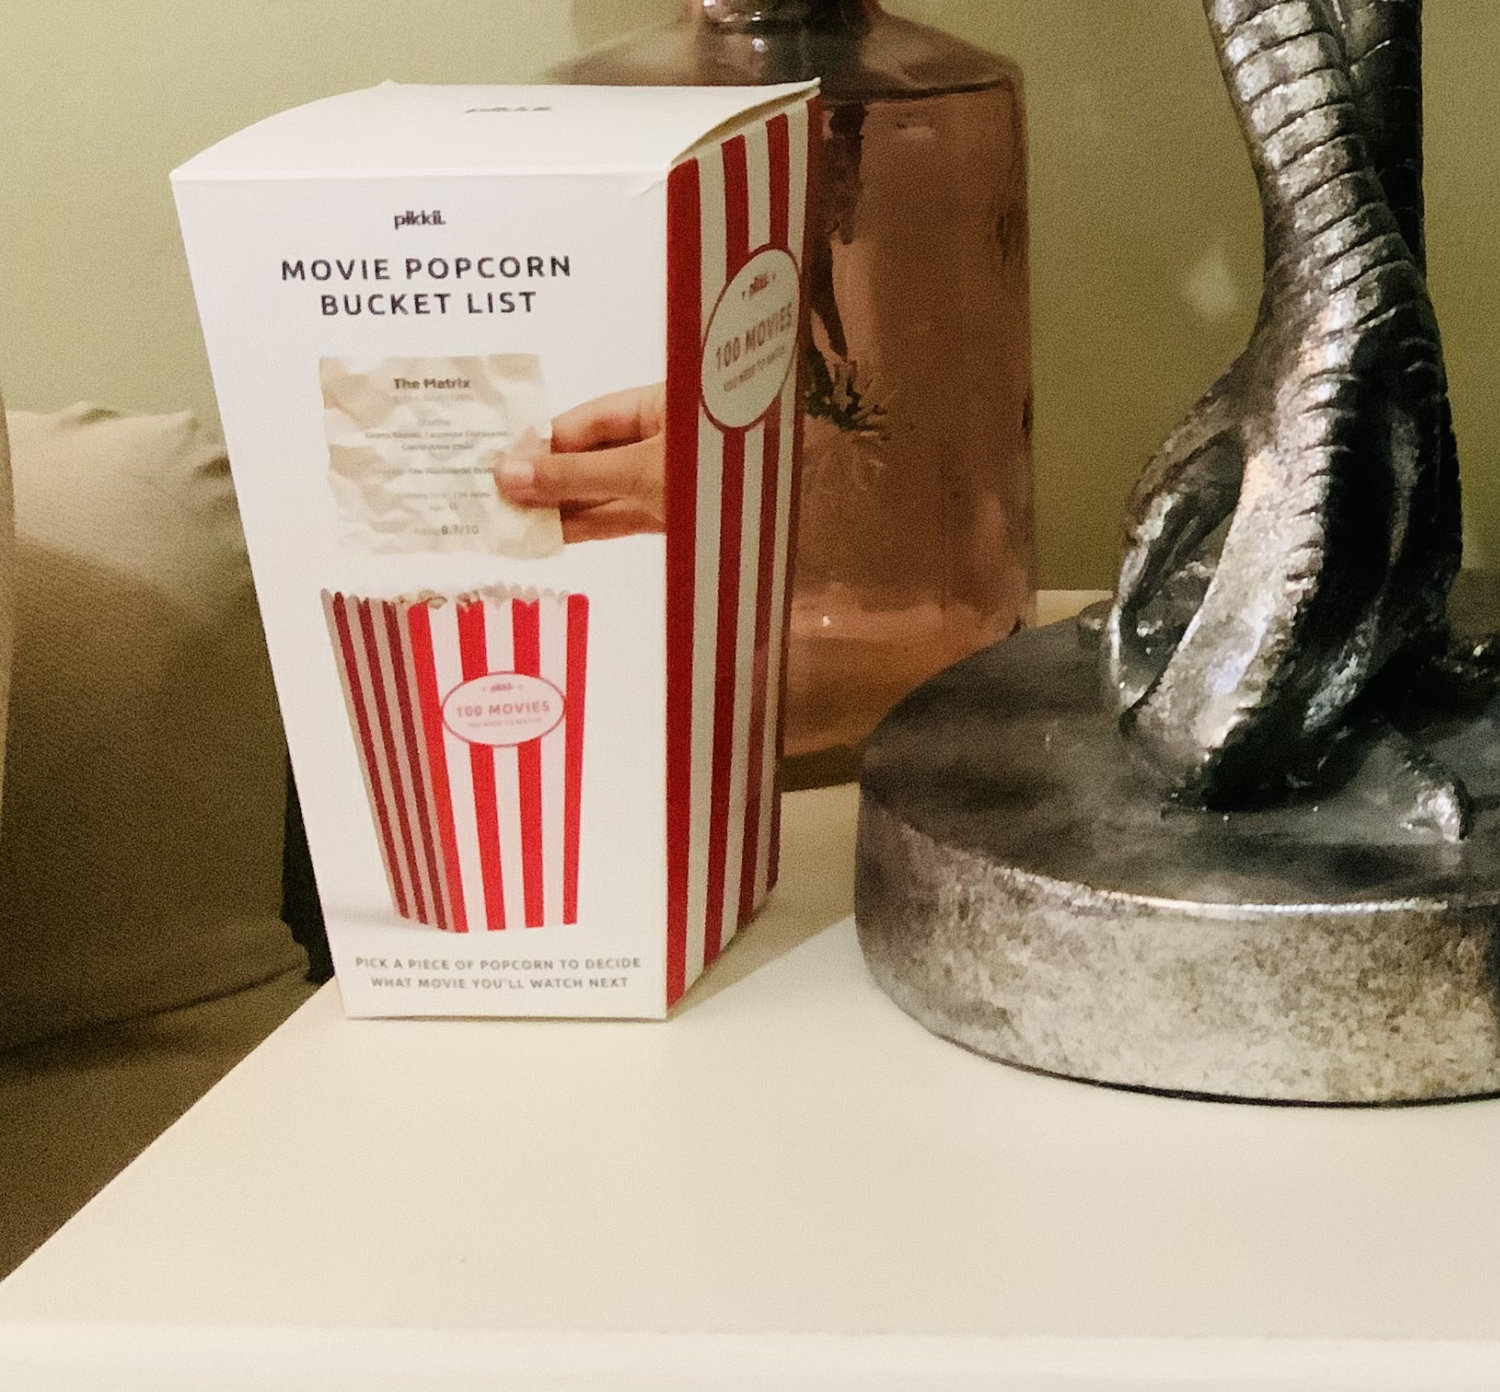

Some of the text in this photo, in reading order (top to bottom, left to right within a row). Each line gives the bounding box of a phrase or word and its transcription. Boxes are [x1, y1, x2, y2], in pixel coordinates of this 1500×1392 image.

[281, 256, 571, 280] MOVIE POPCORN
[320, 291, 537, 316] BUCKET LIST
[716, 336, 741, 372] 100
[746, 302, 793, 352] MOVIES
[393, 377, 472, 390] The Matrix
[456, 700, 550, 718] 100 MOVIES
[355, 956, 641, 970] PICK A PIECE OF POPCORN TO DECIDE
[371, 976, 629, 989] WHAT MOVIE YOU'LL WATCH NEXT
